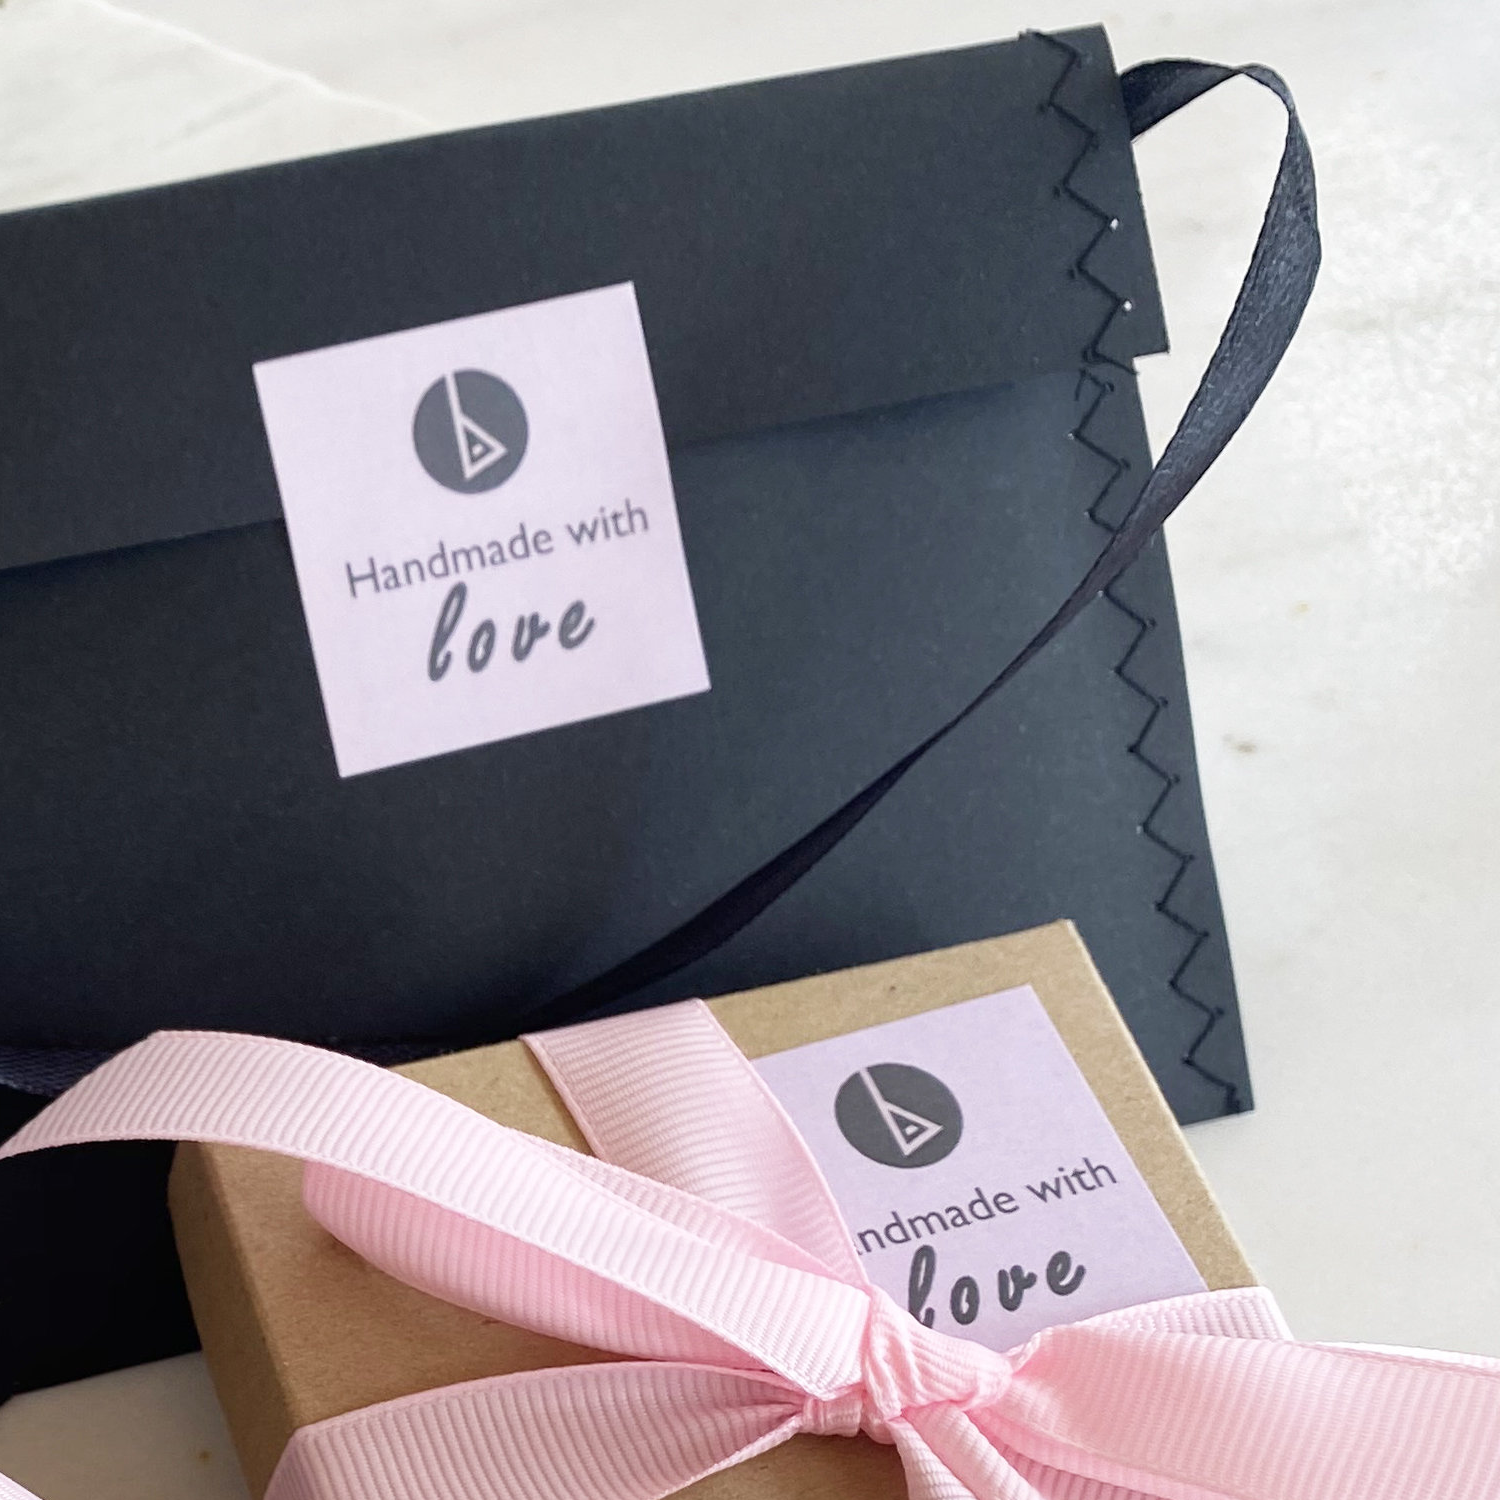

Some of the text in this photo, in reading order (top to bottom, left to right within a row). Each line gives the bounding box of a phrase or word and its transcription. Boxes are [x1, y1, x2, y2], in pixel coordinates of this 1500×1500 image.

[345, 498, 650, 599] Handmade with
[427, 581, 596, 682] love
[855, 1157, 1117, 1256] ndmade with
[907, 1244, 1087, 1329] love
